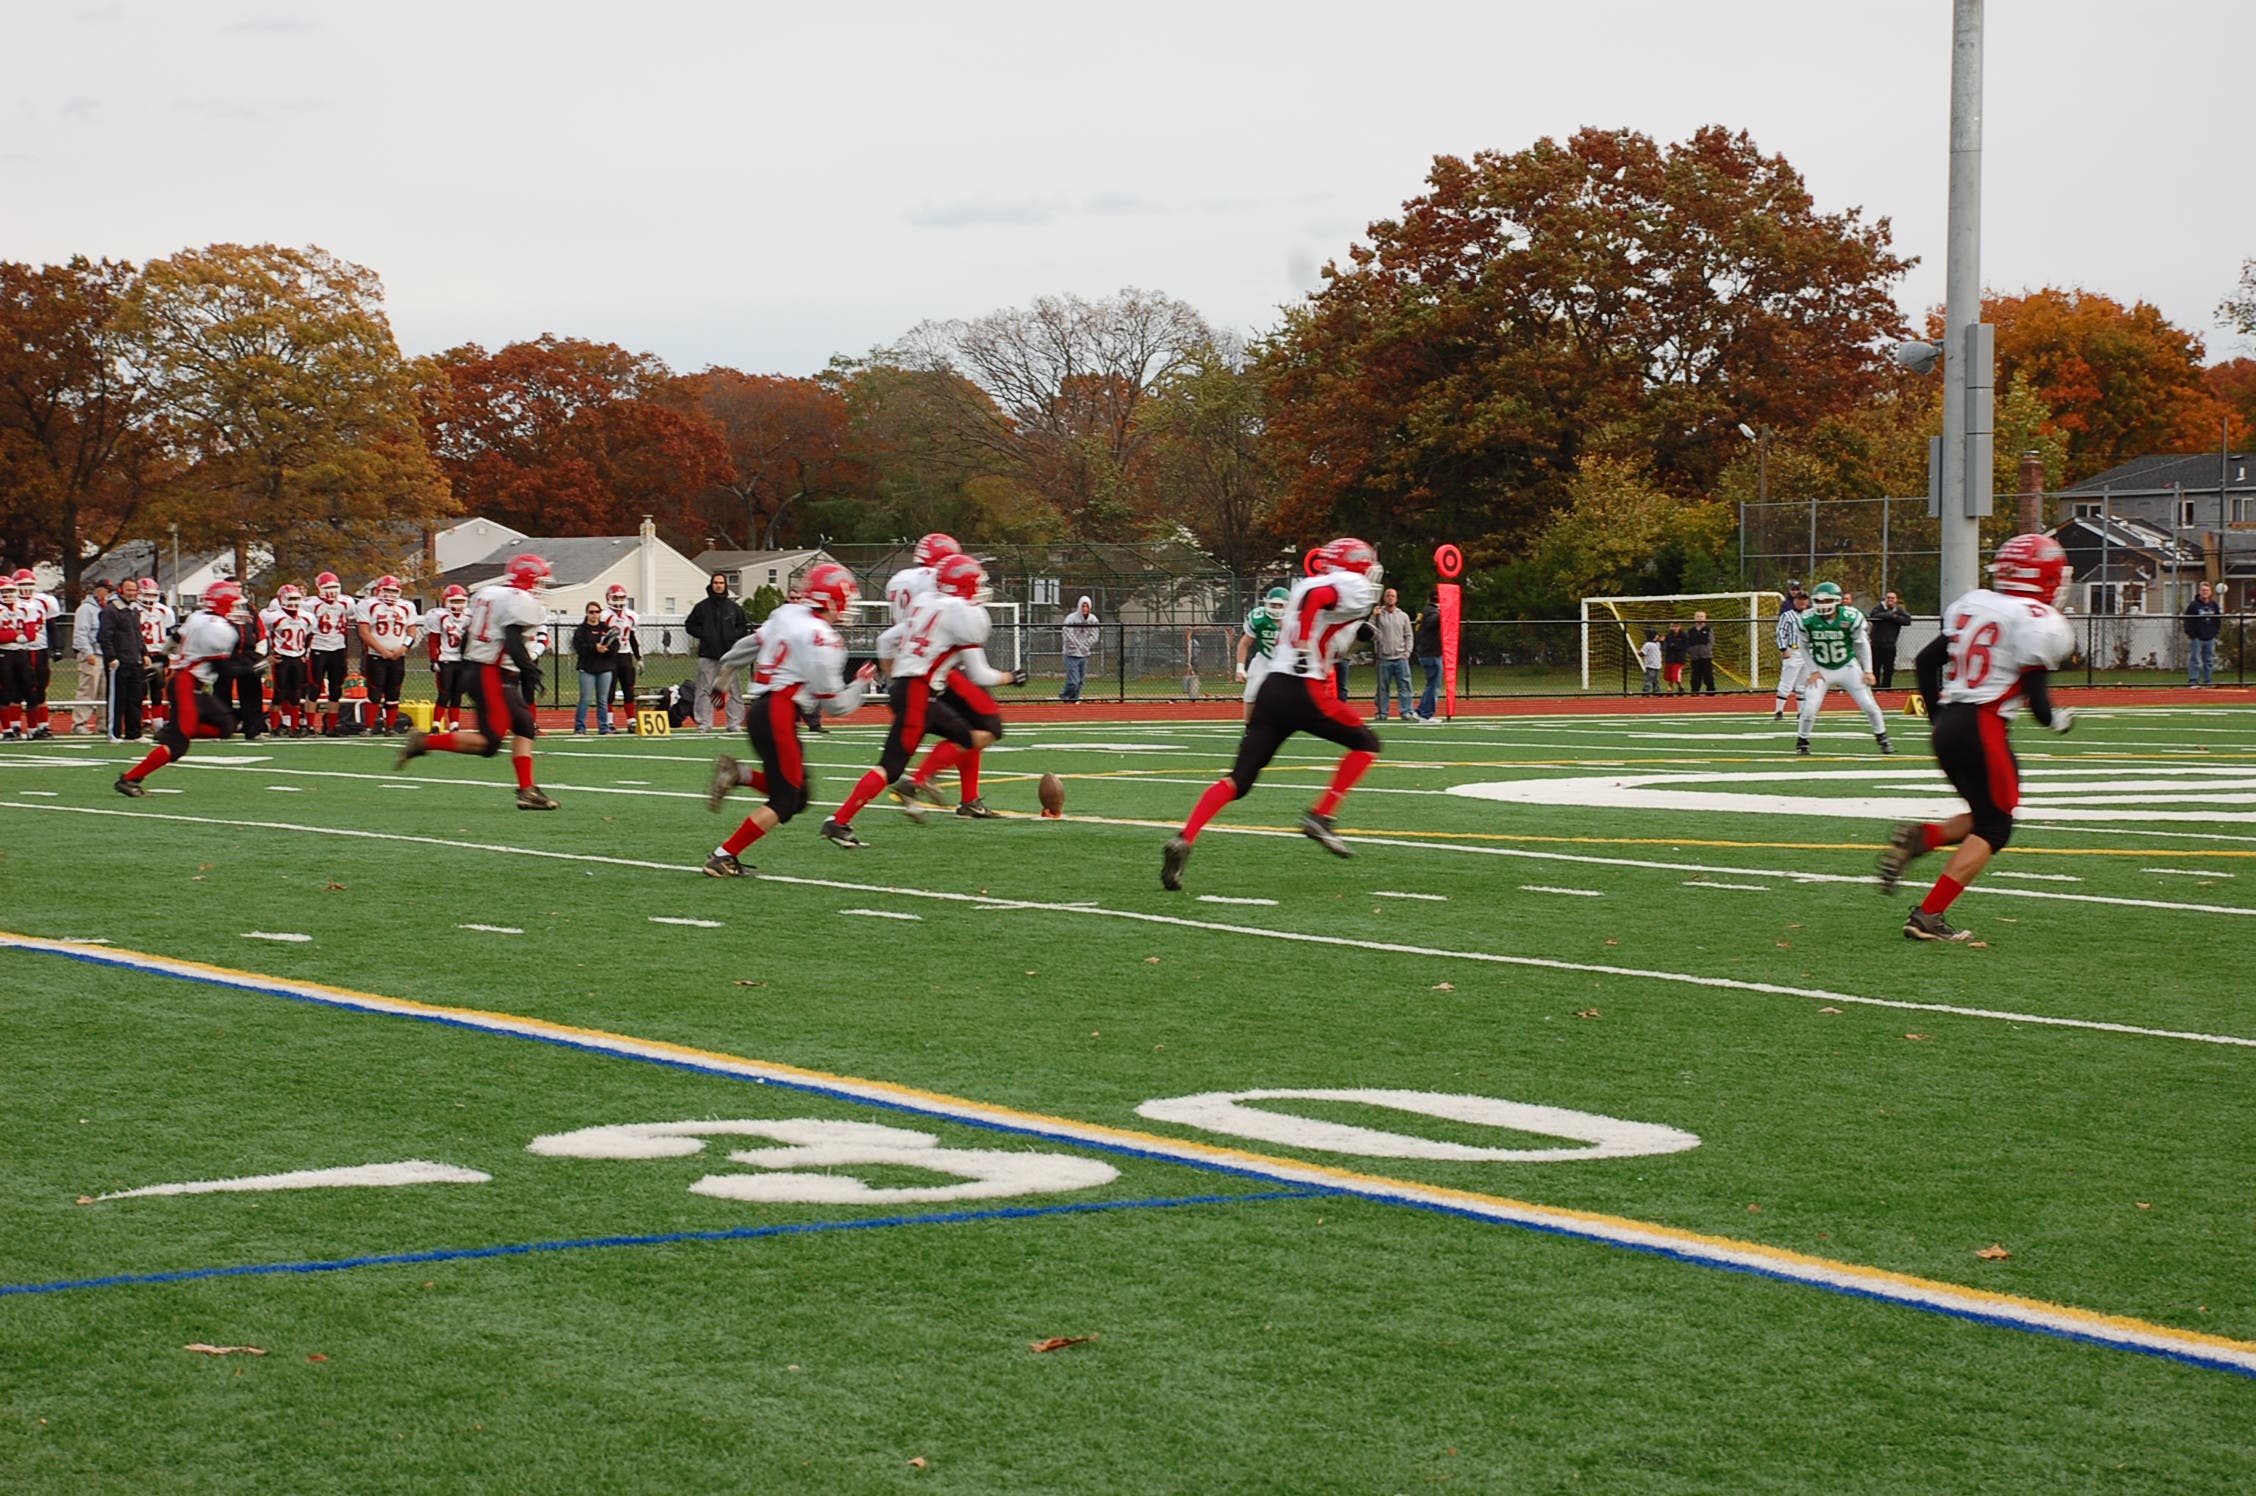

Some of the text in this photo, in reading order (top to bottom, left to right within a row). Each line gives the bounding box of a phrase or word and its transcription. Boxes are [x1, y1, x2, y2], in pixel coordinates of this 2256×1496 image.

[376, 614, 405, 637] 55
[280, 628, 305, 652] 20
[1814, 641, 1848, 664] 36
[643, 713, 666, 735] 50
